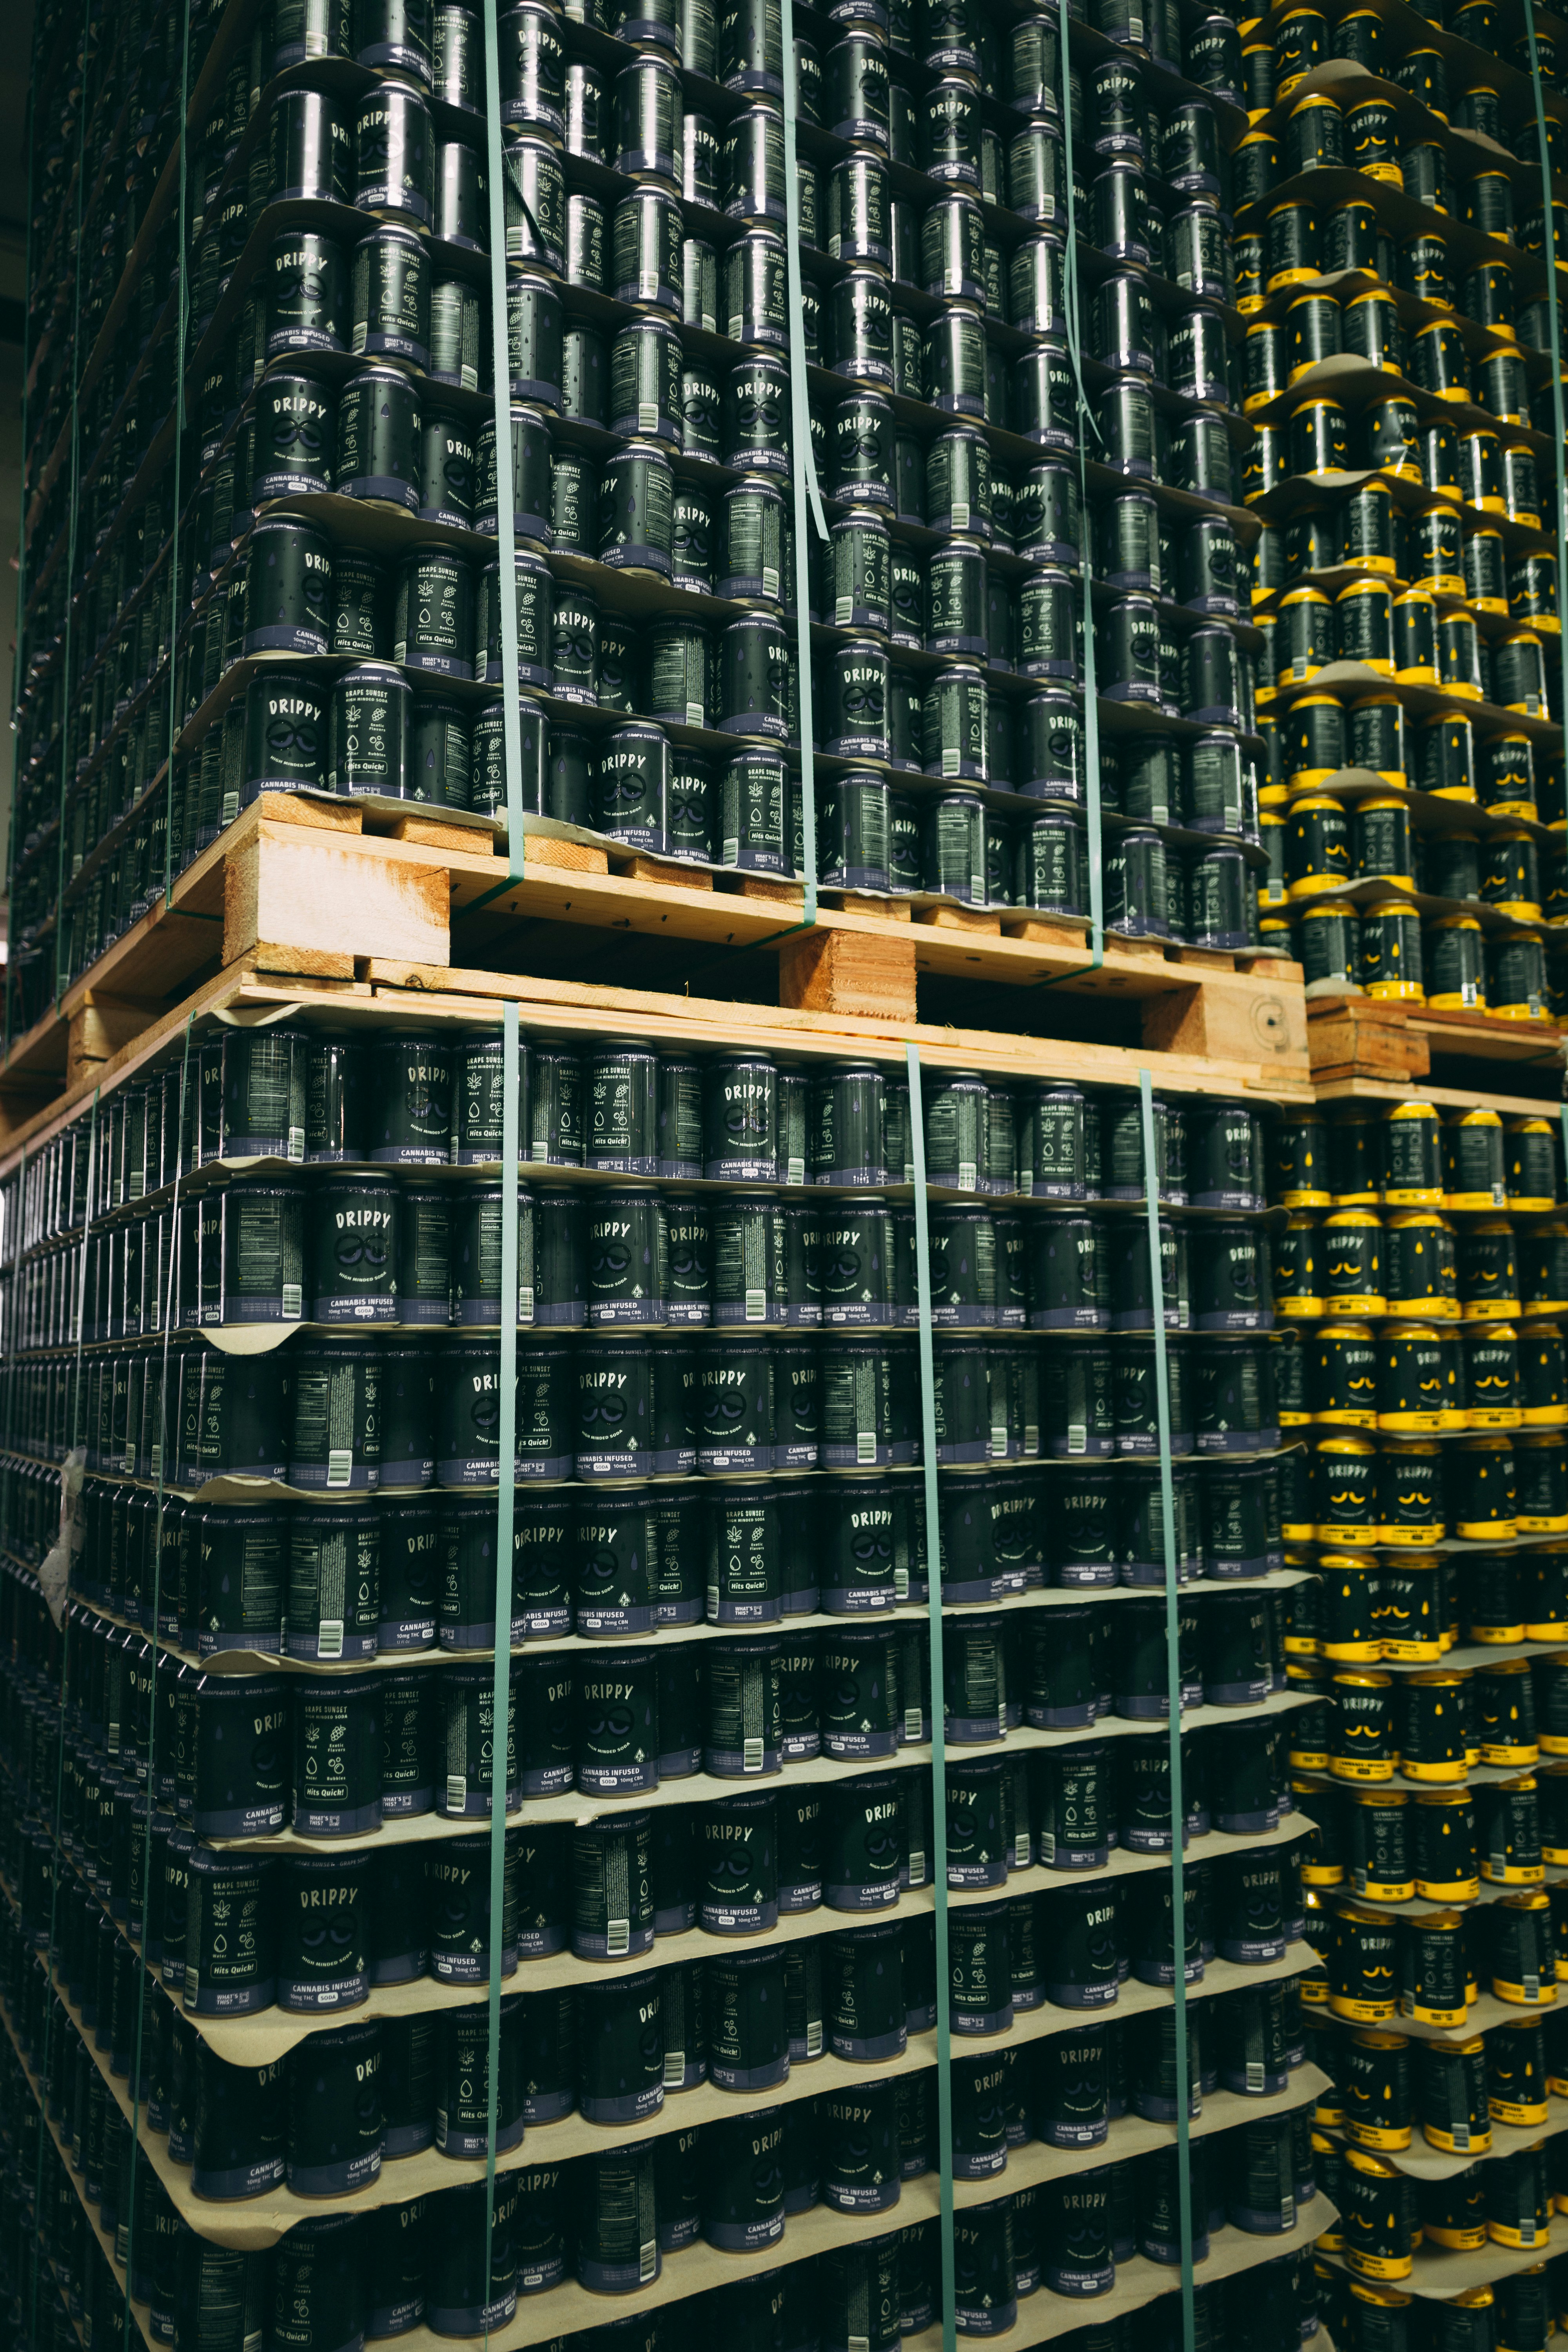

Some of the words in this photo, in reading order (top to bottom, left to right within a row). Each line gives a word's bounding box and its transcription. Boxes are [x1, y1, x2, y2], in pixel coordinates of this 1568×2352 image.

[1097, 77, 1135, 94] DRIPPY
[930, 102, 970, 119] DRIPPY
[277, 251, 327, 272] DRIPPY
[274, 397, 326, 418] DRIPPY
[838, 416, 880, 435] DRIPPY
[301, 477, 327, 492] INFUSED
[837, 483, 863, 495] CANNABIS
[864, 483, 886, 492] INFUSED
[439, 512, 467, 526] CANNABIS
[437, 567, 457, 578] SUNSET
[351, 641, 371, 650] Quick!
[844, 668, 886, 684] DRIPPY
[366, 690, 387, 698] SUNSET
[269, 699, 321, 720] DRIPPY
[602, 754, 646, 773] DRIPPY
[725, 1083, 771, 1102] DRIPPY
[336, 1210, 390, 1228] DRIPPY
[590, 1222, 630, 1240] DRIPPY
[374, 1272, 386, 1280] SODA
[580, 1373, 626, 1389] DRIPPY
[702, 1371, 745, 1386] DRIPPY
[610, 1430, 622, 1438] SODA
[467, 1461, 501, 1470] CANNABIS
[851, 1511, 891, 1527] DRIPPY
[585, 1684, 633, 1700] DRIPPY
[1343, 1698, 1383, 1711] DRIPPY
[588, 1743, 596, 1751] HIGH
[617, 1742, 630, 1751] SODA
[544, 1766, 570, 1779] CANNABIS
[246, 1808, 278, 1818] CANNABIS
[706, 1825, 753, 1841] DRIPPY
[232, 1880, 259, 1888] SUNSET
[301, 1888, 358, 1907] DRIPPY
[302, 1956, 314, 1965] HIGH
[339, 1951, 352, 1963] SODA
[231, 1964, 253, 1974] Quick!
[332, 1978, 361, 1990] INFUSED
[1061, 2048, 1102, 2063] DRIPPY
[638, 2085, 662, 2102] CANNABIS
[1063, 2194, 1105, 2209] DRIPPY
[748, 2221, 776, 2233] CANNABIS
